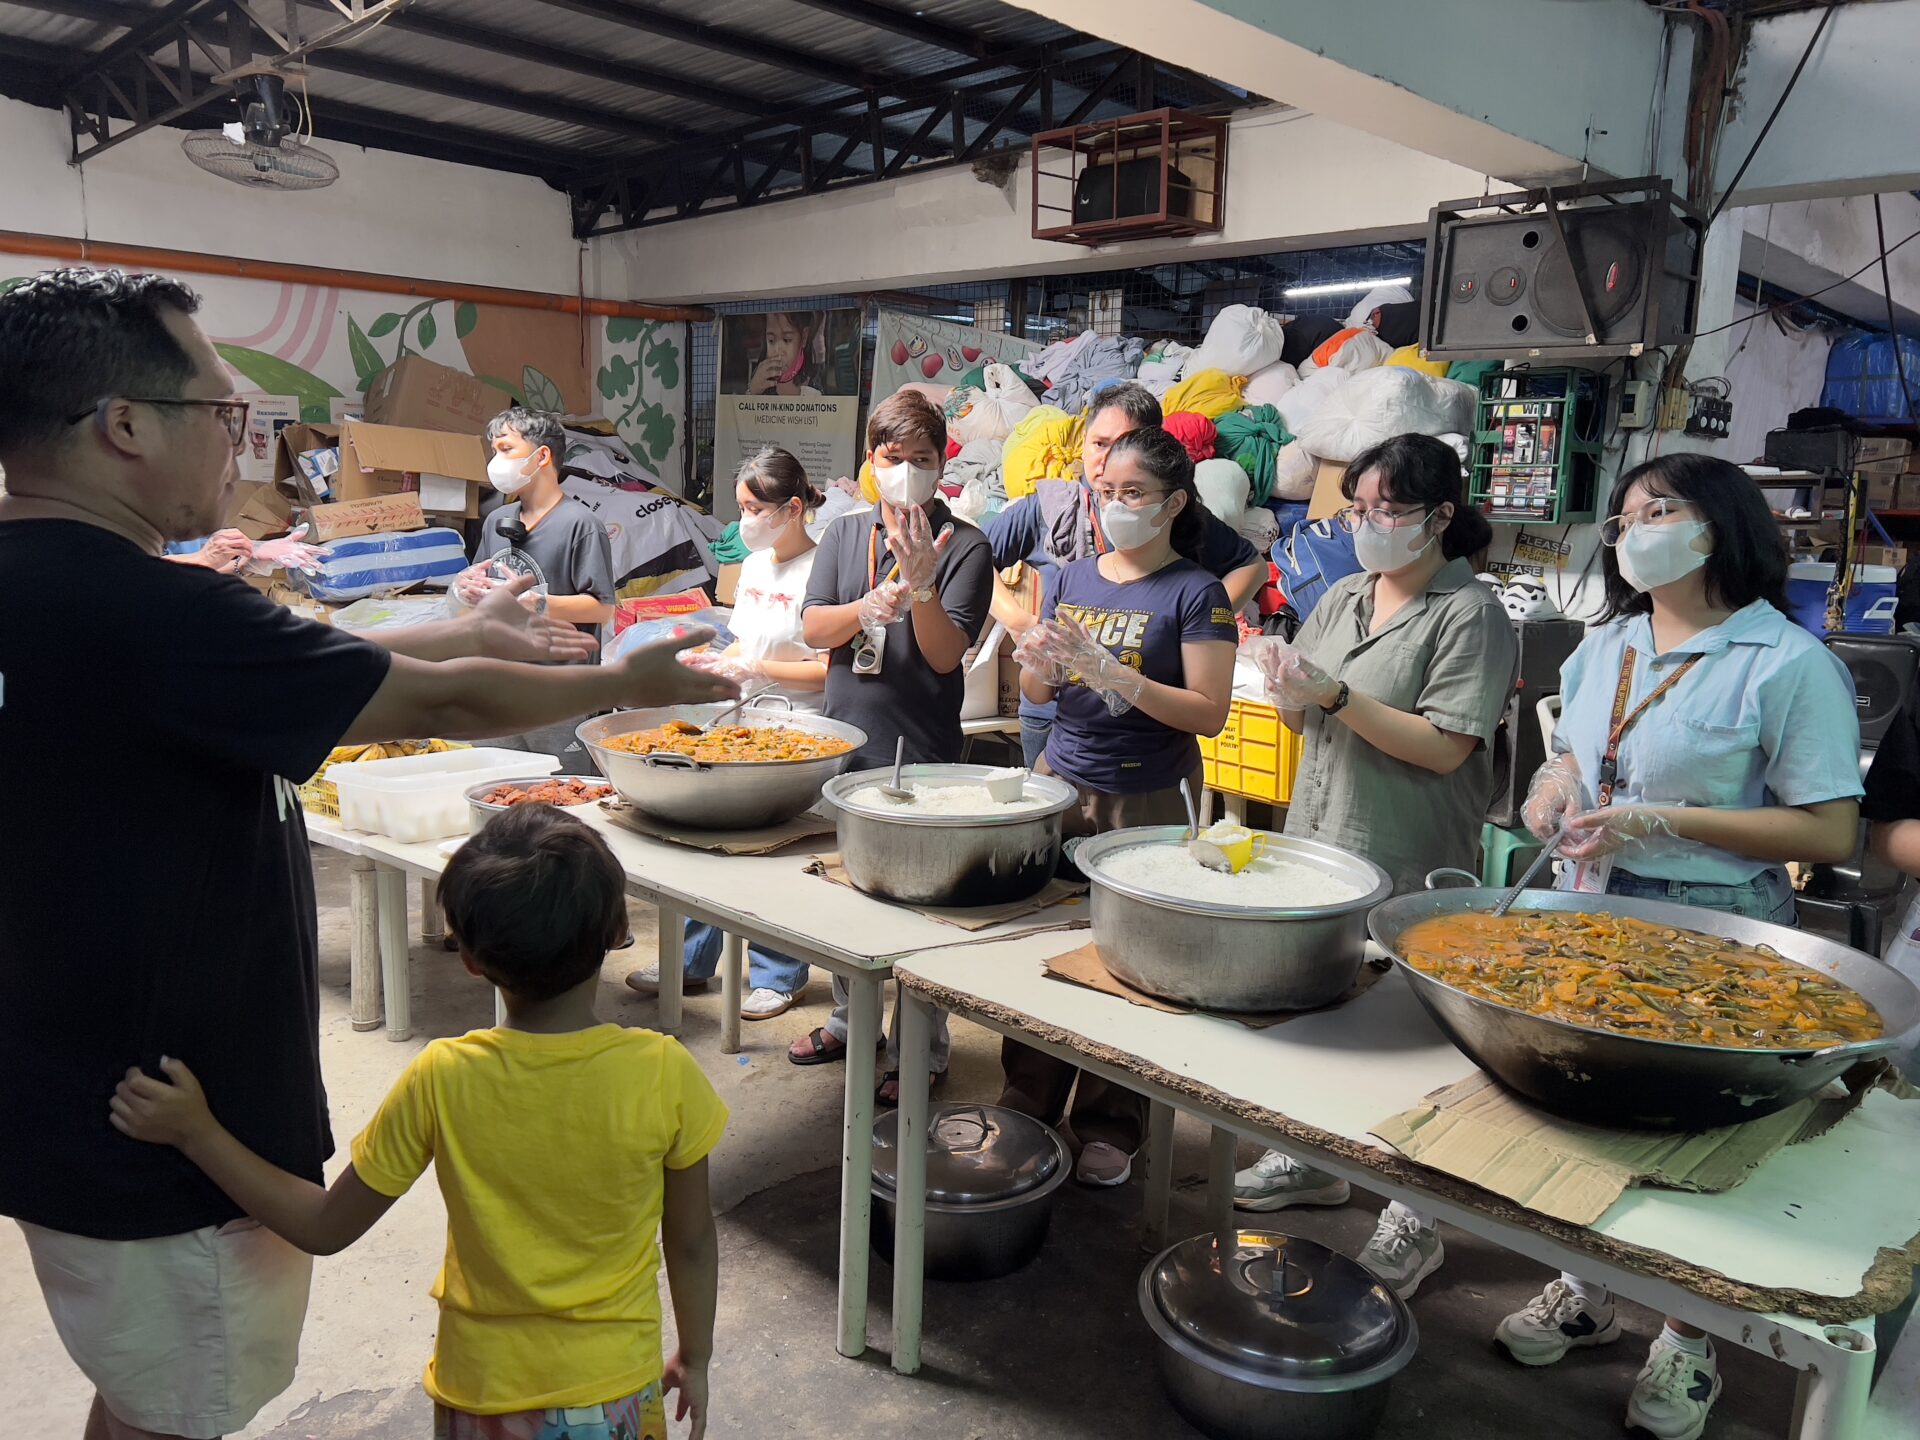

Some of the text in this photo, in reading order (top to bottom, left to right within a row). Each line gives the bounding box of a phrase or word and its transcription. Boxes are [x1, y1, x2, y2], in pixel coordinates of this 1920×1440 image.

[739, 402, 837, 412] CALL FOR IN-KIND DONATIONS
[754, 415, 786, 425] (MEDICINE
[787, 416, 802, 425] WISH
[1520, 534, 1568, 553] PLEASE
[1489, 563, 1541, 576] PLEASE
